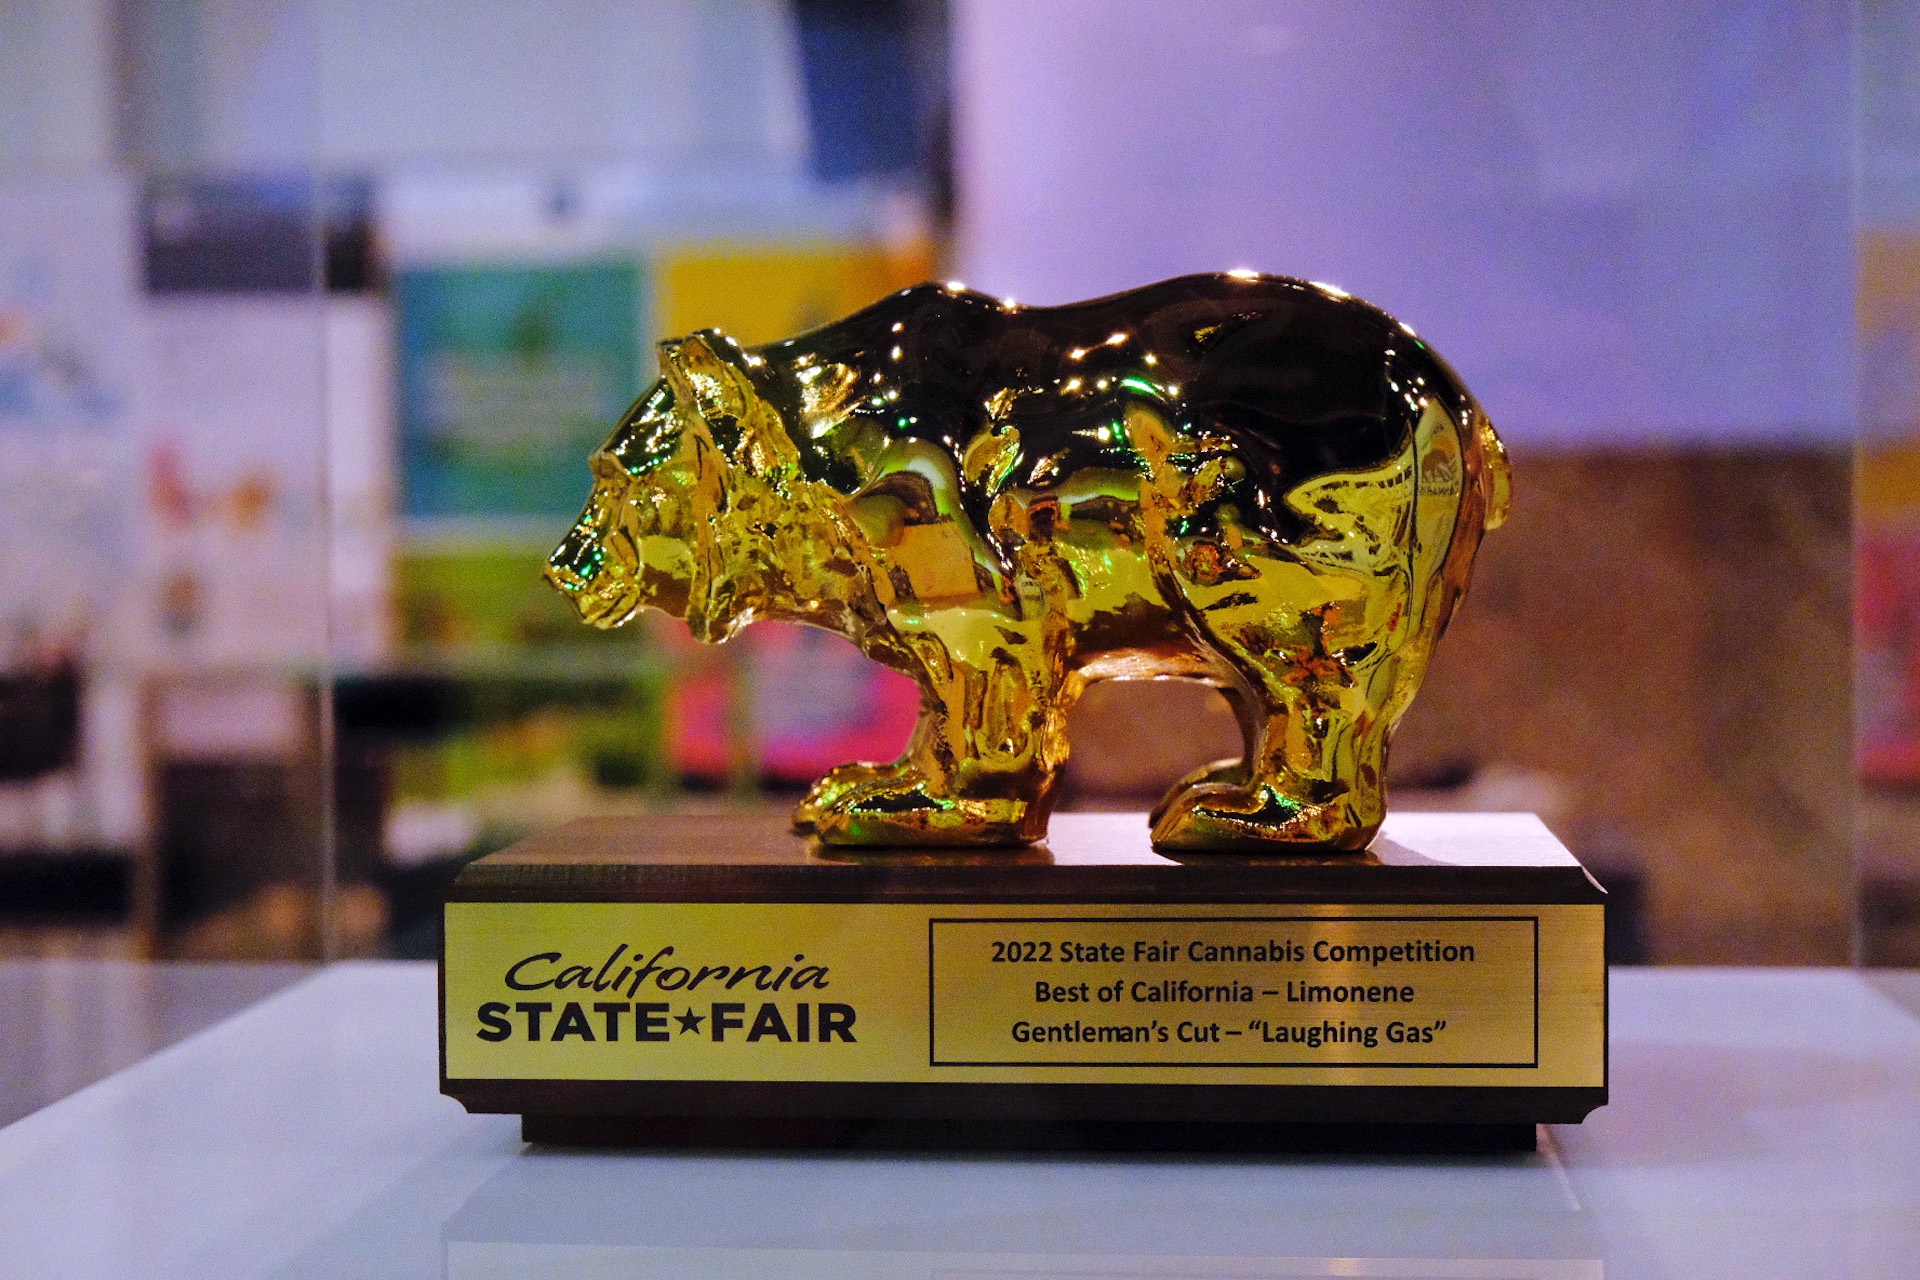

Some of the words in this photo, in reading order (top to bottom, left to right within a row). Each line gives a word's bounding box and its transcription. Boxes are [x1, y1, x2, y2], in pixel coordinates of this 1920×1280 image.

[991, 941, 1053, 963] 2022
[1060, 940, 1125, 963] State
[1133, 940, 1180, 963] Fair
[1187, 940, 1305, 963] Cannabis
[1312, 940, 1475, 967] Competition
[505, 943, 830, 999] California
[1035, 981, 1090, 1003] Best
[1096, 980, 1125, 1003] of
[1130, 980, 1255, 1003] California
[1286, 981, 1415, 1003] Limonene
[476, 1002, 671, 1042] STATE
[711, 1003, 857, 1042] FAIR
[1177, 1021, 1220, 1043] Cut
